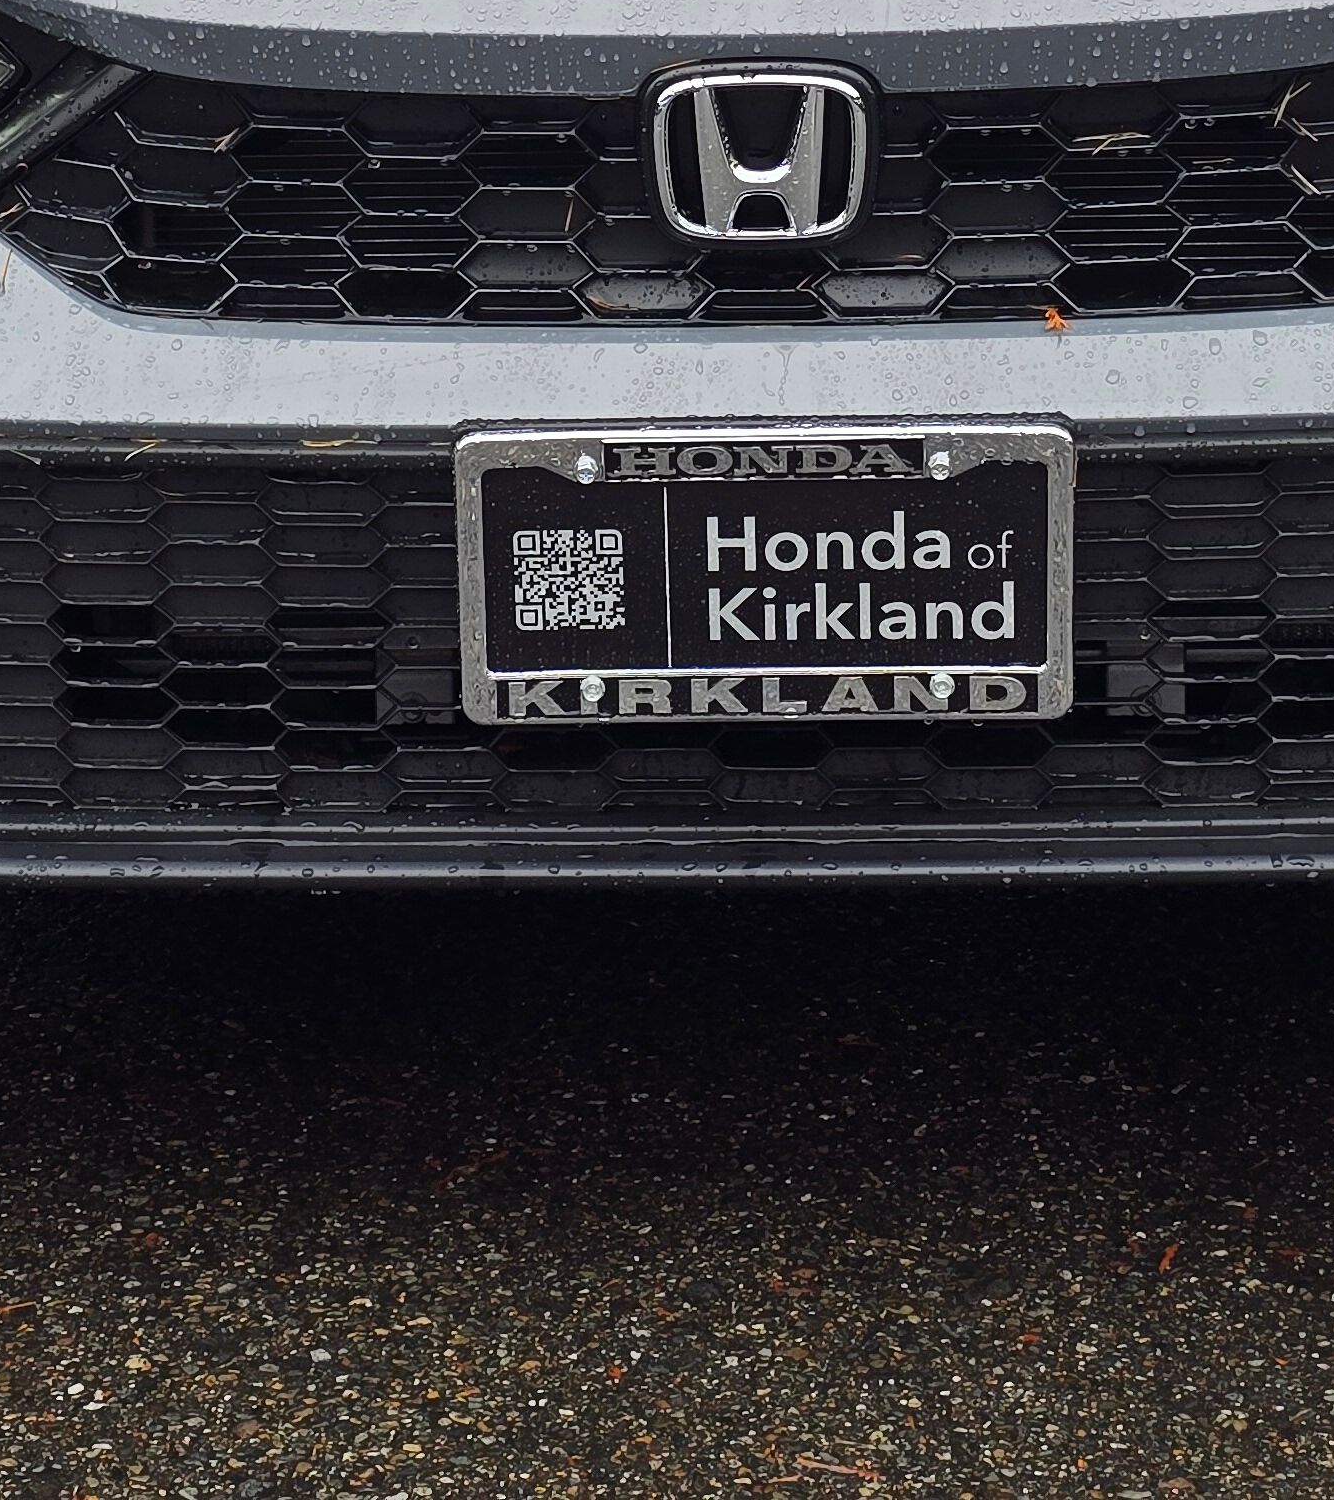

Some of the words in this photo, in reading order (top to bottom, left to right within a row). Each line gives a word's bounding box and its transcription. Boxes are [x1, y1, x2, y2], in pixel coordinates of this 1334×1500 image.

[609, 444, 915, 476] HONDA
[707, 511, 951, 571] Honda
[967, 530, 1014, 569] of
[708, 581, 1015, 641] Kirkland
